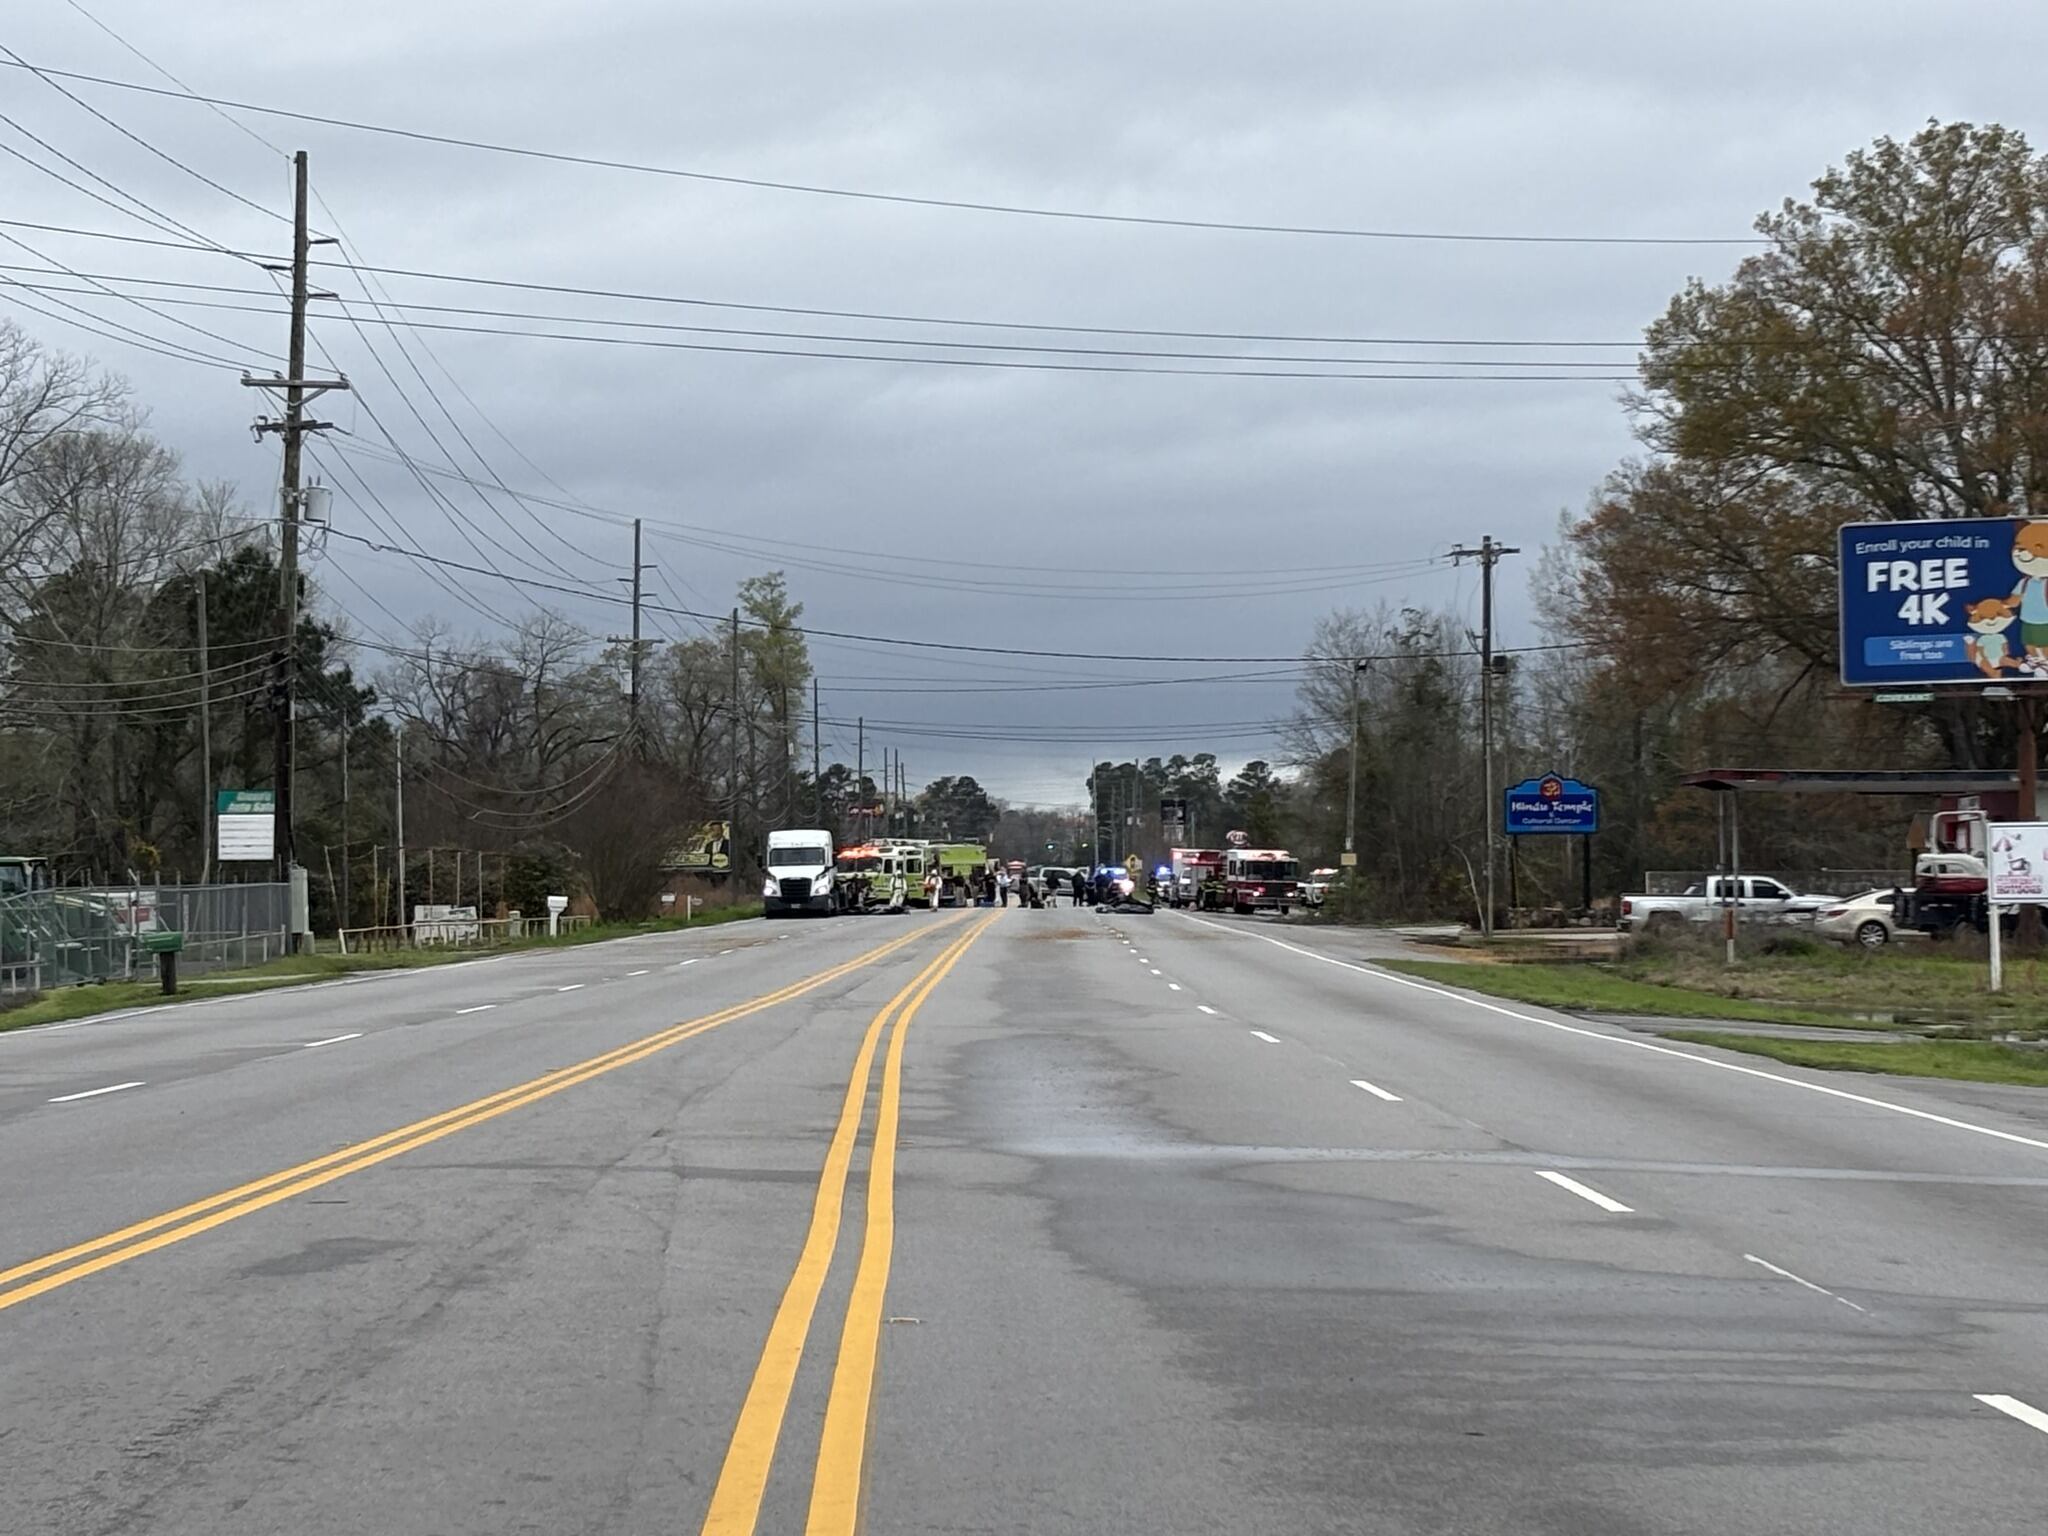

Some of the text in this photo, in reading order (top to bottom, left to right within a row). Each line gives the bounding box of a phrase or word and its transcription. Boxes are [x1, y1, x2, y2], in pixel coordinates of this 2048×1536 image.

[1855, 536, 1990, 554] Enroll your child in
[1867, 558, 1969, 592] FREE
[1898, 592, 1950, 625] 4K
[1512, 801, 1592, 813] Hindu Temple
